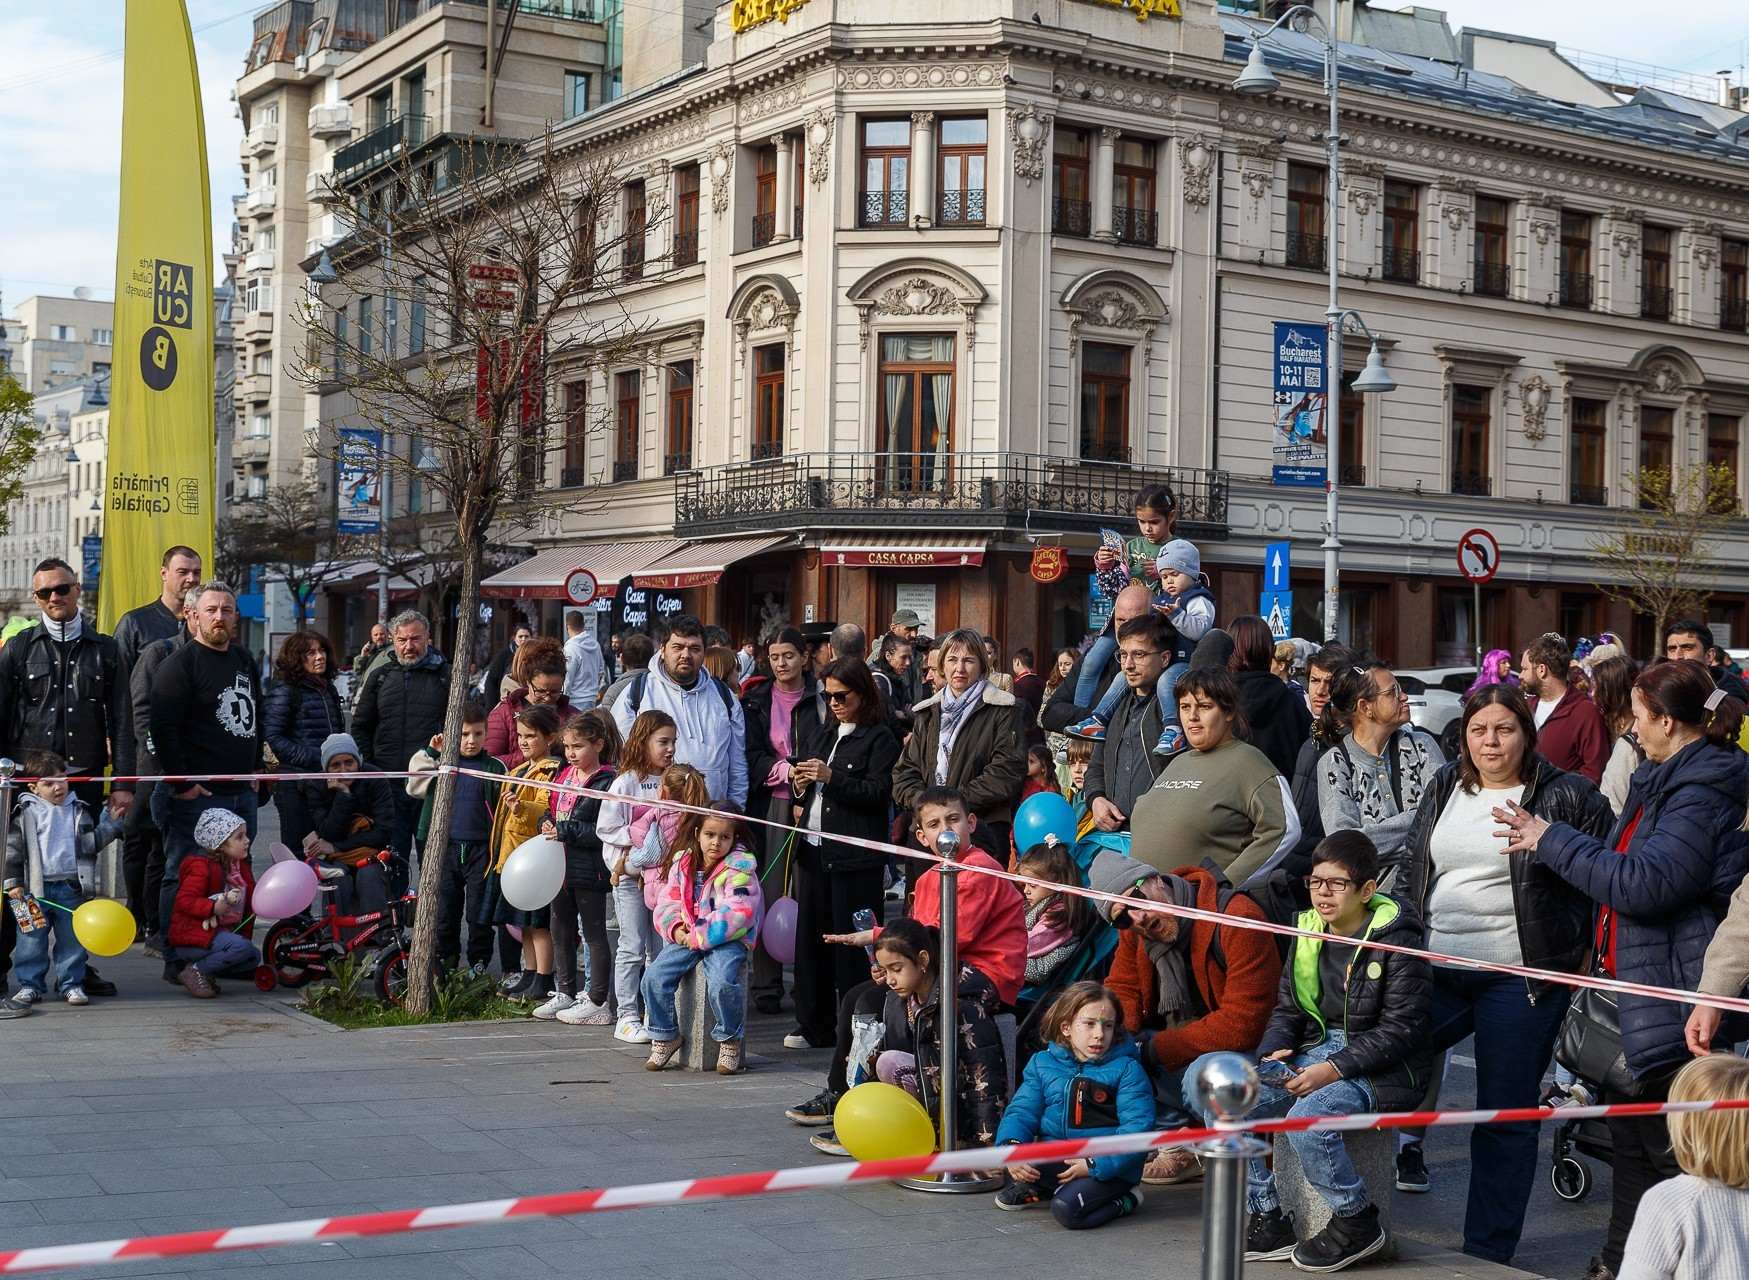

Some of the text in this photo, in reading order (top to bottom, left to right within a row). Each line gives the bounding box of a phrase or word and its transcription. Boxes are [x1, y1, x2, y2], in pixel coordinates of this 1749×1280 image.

[1279, 345, 1322, 359] Bucharest
[1279, 365, 1302, 375] 10-11
[1280, 375, 1302, 387] MAI
[868, 553, 934, 564] CASA CAPSA
[625, 586, 646, 604] Casa
